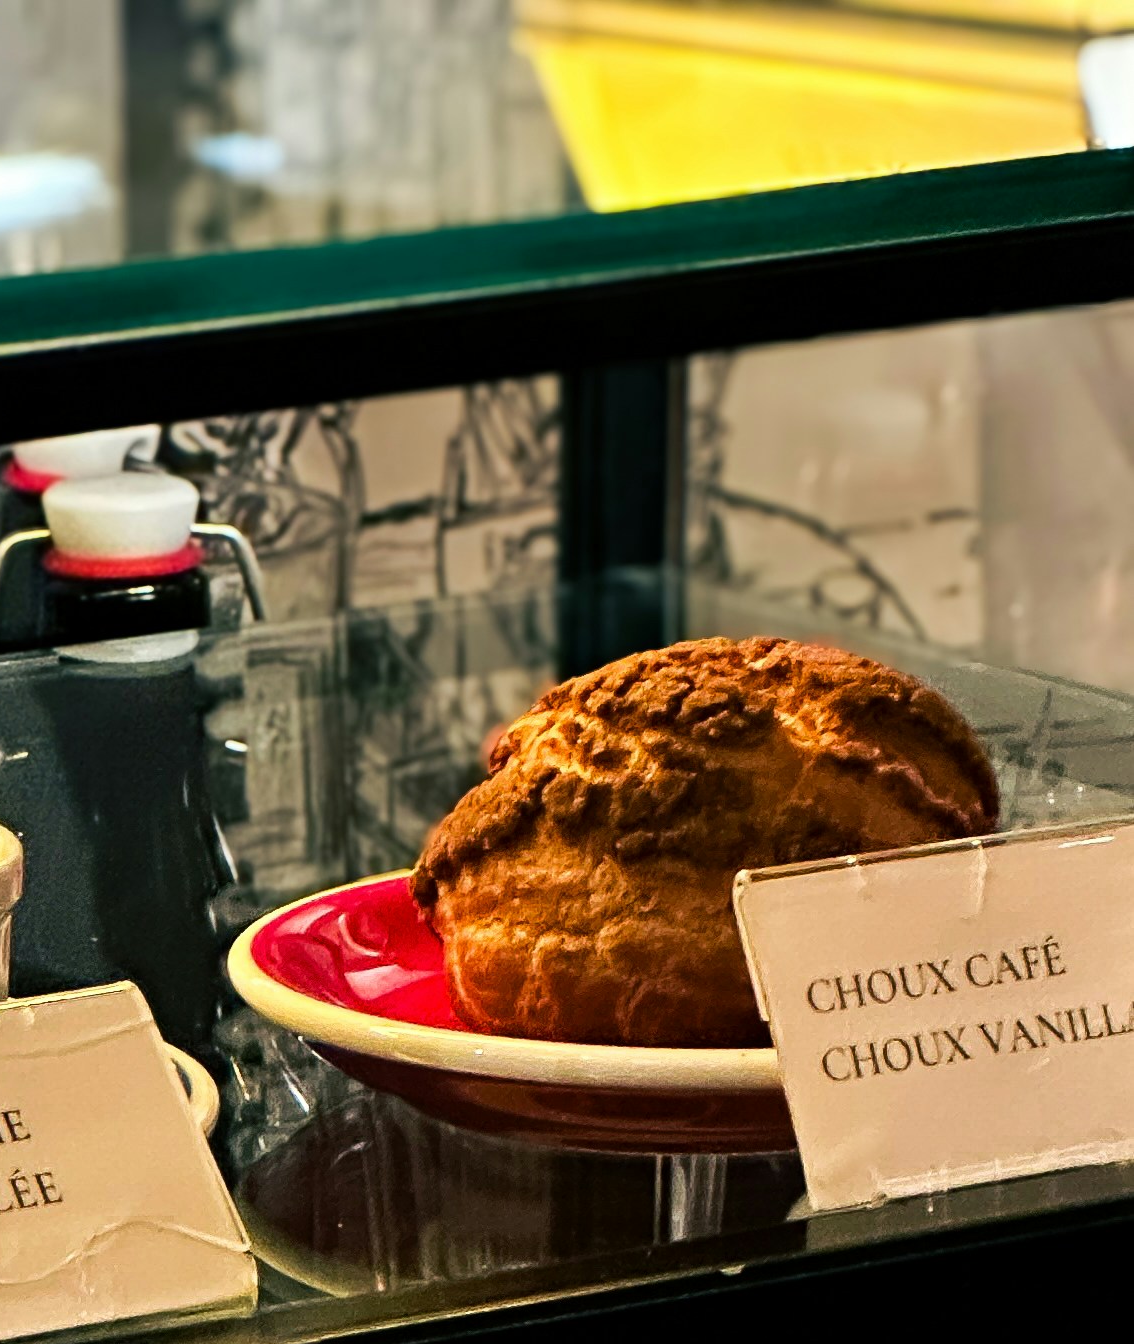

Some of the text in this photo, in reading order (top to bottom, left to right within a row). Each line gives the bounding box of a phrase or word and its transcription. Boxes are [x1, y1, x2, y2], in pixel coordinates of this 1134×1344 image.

[807, 936, 1066, 1013] CHOUX CAFÉ
[822, 1026, 971, 1082] CHOUX
